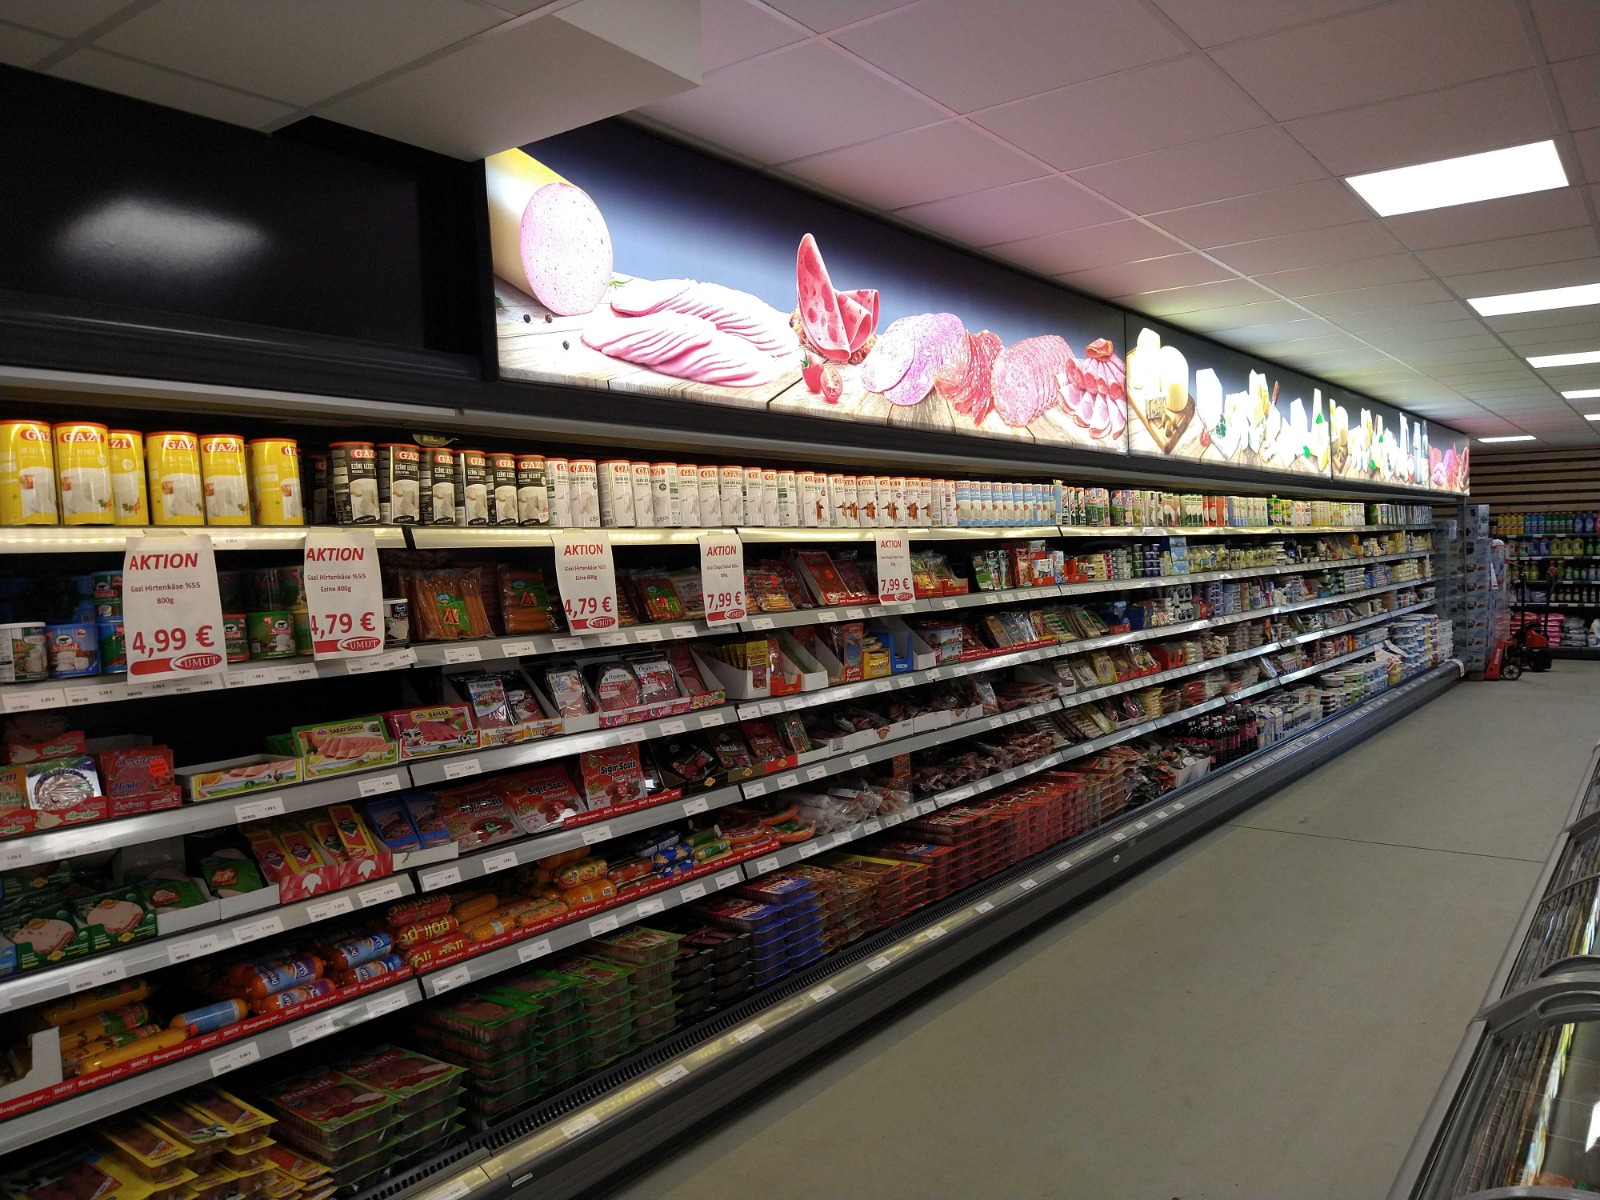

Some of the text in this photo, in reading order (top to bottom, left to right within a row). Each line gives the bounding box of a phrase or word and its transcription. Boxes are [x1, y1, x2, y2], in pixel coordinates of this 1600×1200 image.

[25, 430, 50, 441] GAZ
[63, 432, 104, 443] GAZI
[109, 440, 129, 449] ZI
[207, 443, 241, 453] GAZI
[285, 446, 297, 456] GA
[354, 449, 375, 458] GAZ
[399, 451, 420, 462] GAZ
[438, 455, 453, 464] GA
[471, 457, 485, 466] GA
[499, 460, 515, 469] GA
[521, 461, 544, 470] GAZI
[618, 465, 630, 473] GA
[639, 467, 650, 475] GA
[881, 540, 901, 548] AKTION
[306, 547, 364, 561] AKTION
[564, 544, 603, 556] AKTION
[707, 545, 737, 556] AKTION
[129, 553, 198, 570] AKTION
[130, 581, 201, 593] Gazi Hirtenkäse %55
[881, 578, 910, 593] 7,99 €
[157, 597, 174, 605] 800g
[707, 591, 742, 611] 7,99 €
[565, 596, 612, 618] 4,79 €
[311, 612, 375, 639] 4,79 €
[594, 619, 613, 627] UMUT
[132, 625, 214, 658] 4,99 €
[350, 640, 378, 650] UMUT
[184, 656, 218, 668] UMUT
[619, 760, 637, 770] Sosis
[113, 781, 138, 792] Hindi
[546, 781, 567, 791] Sosis
[388, 903, 407, 916] oli
[400, 916, 450, 944] poli po
[279, 1077, 335, 1103] Sucuk
